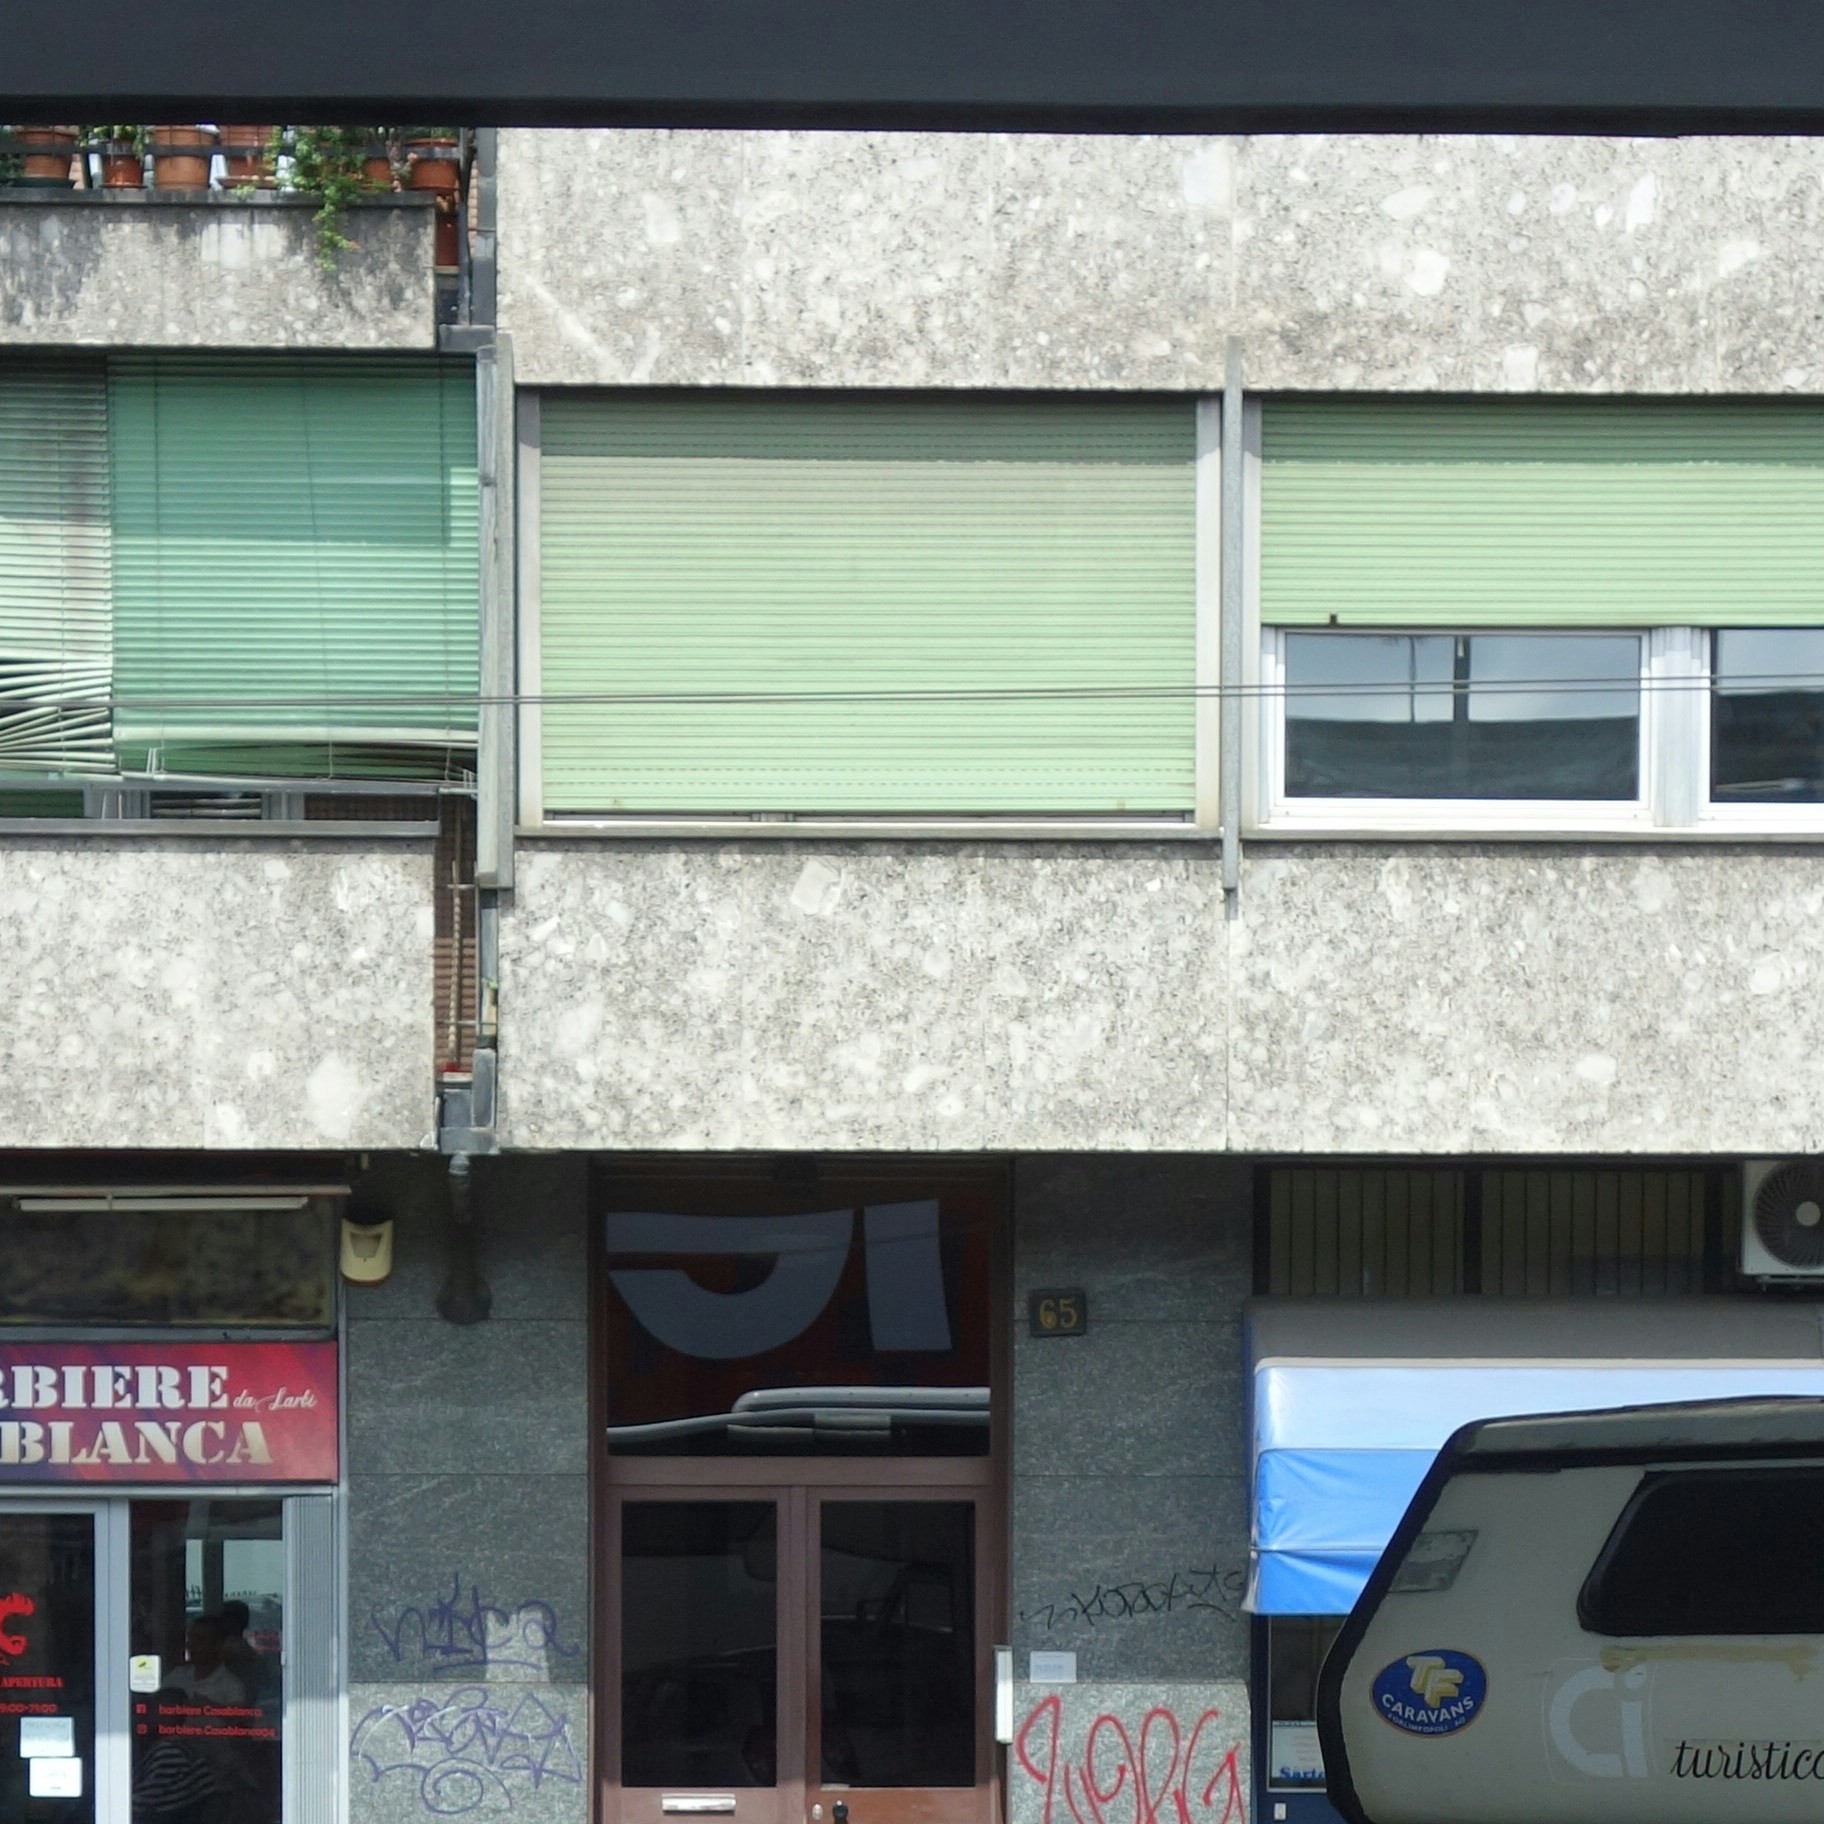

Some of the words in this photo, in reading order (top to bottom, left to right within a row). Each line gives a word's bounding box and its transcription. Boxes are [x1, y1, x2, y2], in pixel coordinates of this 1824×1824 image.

[1038, 1299, 1079, 1329] 65
[232, 1389, 257, 1409] da
[1, 1676, 63, 1688] APERTURA
[159, 1705, 202, 1715] barbiere
[1381, 1693, 1474, 1724] CARAVANS
